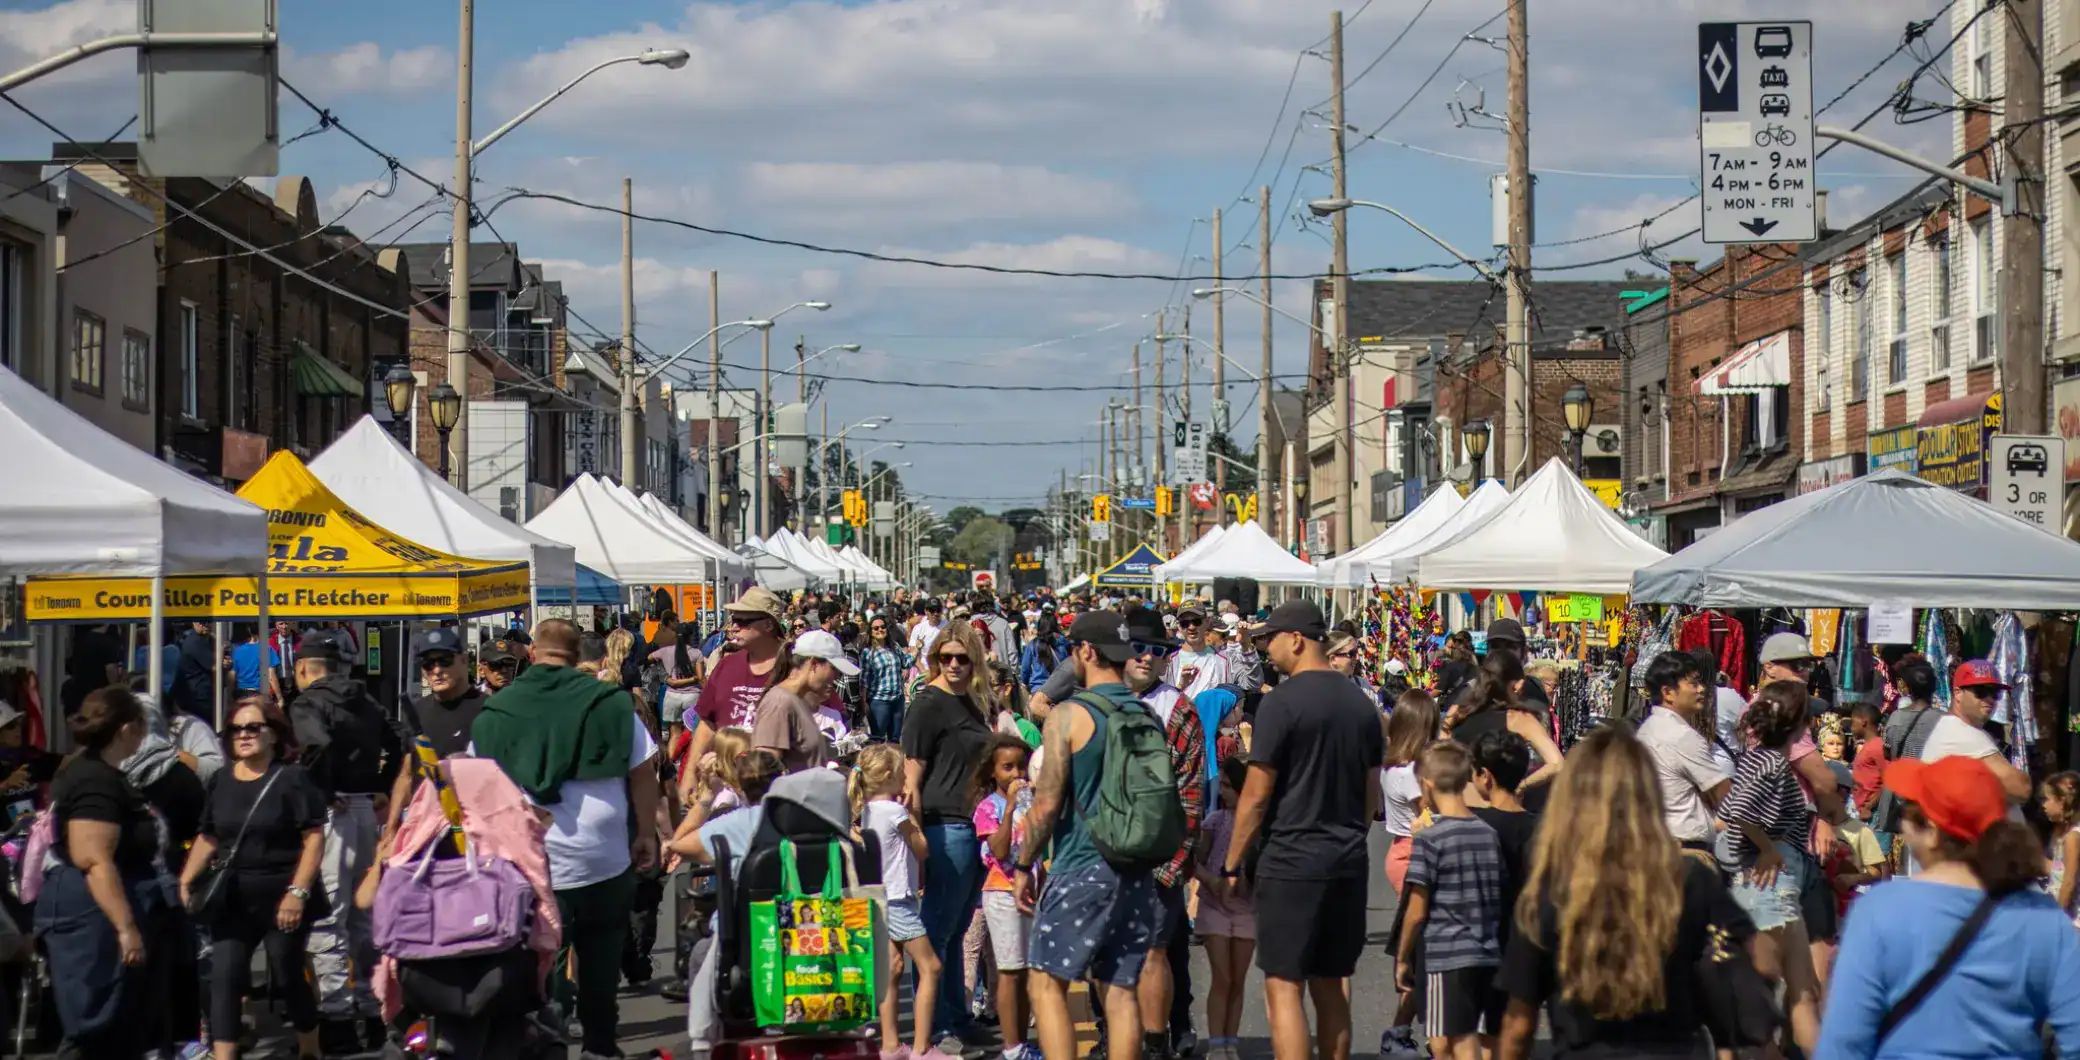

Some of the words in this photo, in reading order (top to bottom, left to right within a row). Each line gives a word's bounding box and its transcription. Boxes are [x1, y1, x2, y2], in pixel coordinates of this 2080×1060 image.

[1764, 73, 1785, 82] TAXI
[1784, 158, 1807, 169] AM
[1711, 174, 1724, 191] 4
[1729, 180, 1749, 191] PM
[1768, 172, 1780, 190] 6
[1783, 179, 1804, 190] PM
[1724, 199, 1755, 210] MON
[1771, 197, 1794, 209] FRI
[1924, 424, 1956, 459] DOLLAR
[1958, 421, 1980, 457] STORE
[1956, 460, 1980, 484] OUTLET
[2006, 483, 2020, 503] 3
[2029, 491, 2047, 504] OR
[267, 509, 327, 528] RONTO
[2011, 510, 2045, 524] ORE
[267, 536, 349, 561] ula
[47, 596, 82, 609] TORONTO
[94, 589, 213, 609] Counillor
[295, 588, 389, 606] Fletcher
[416, 593, 452, 607] TORONTO
[795, 964, 820, 973] food
[784, 971, 833, 986] Basics
